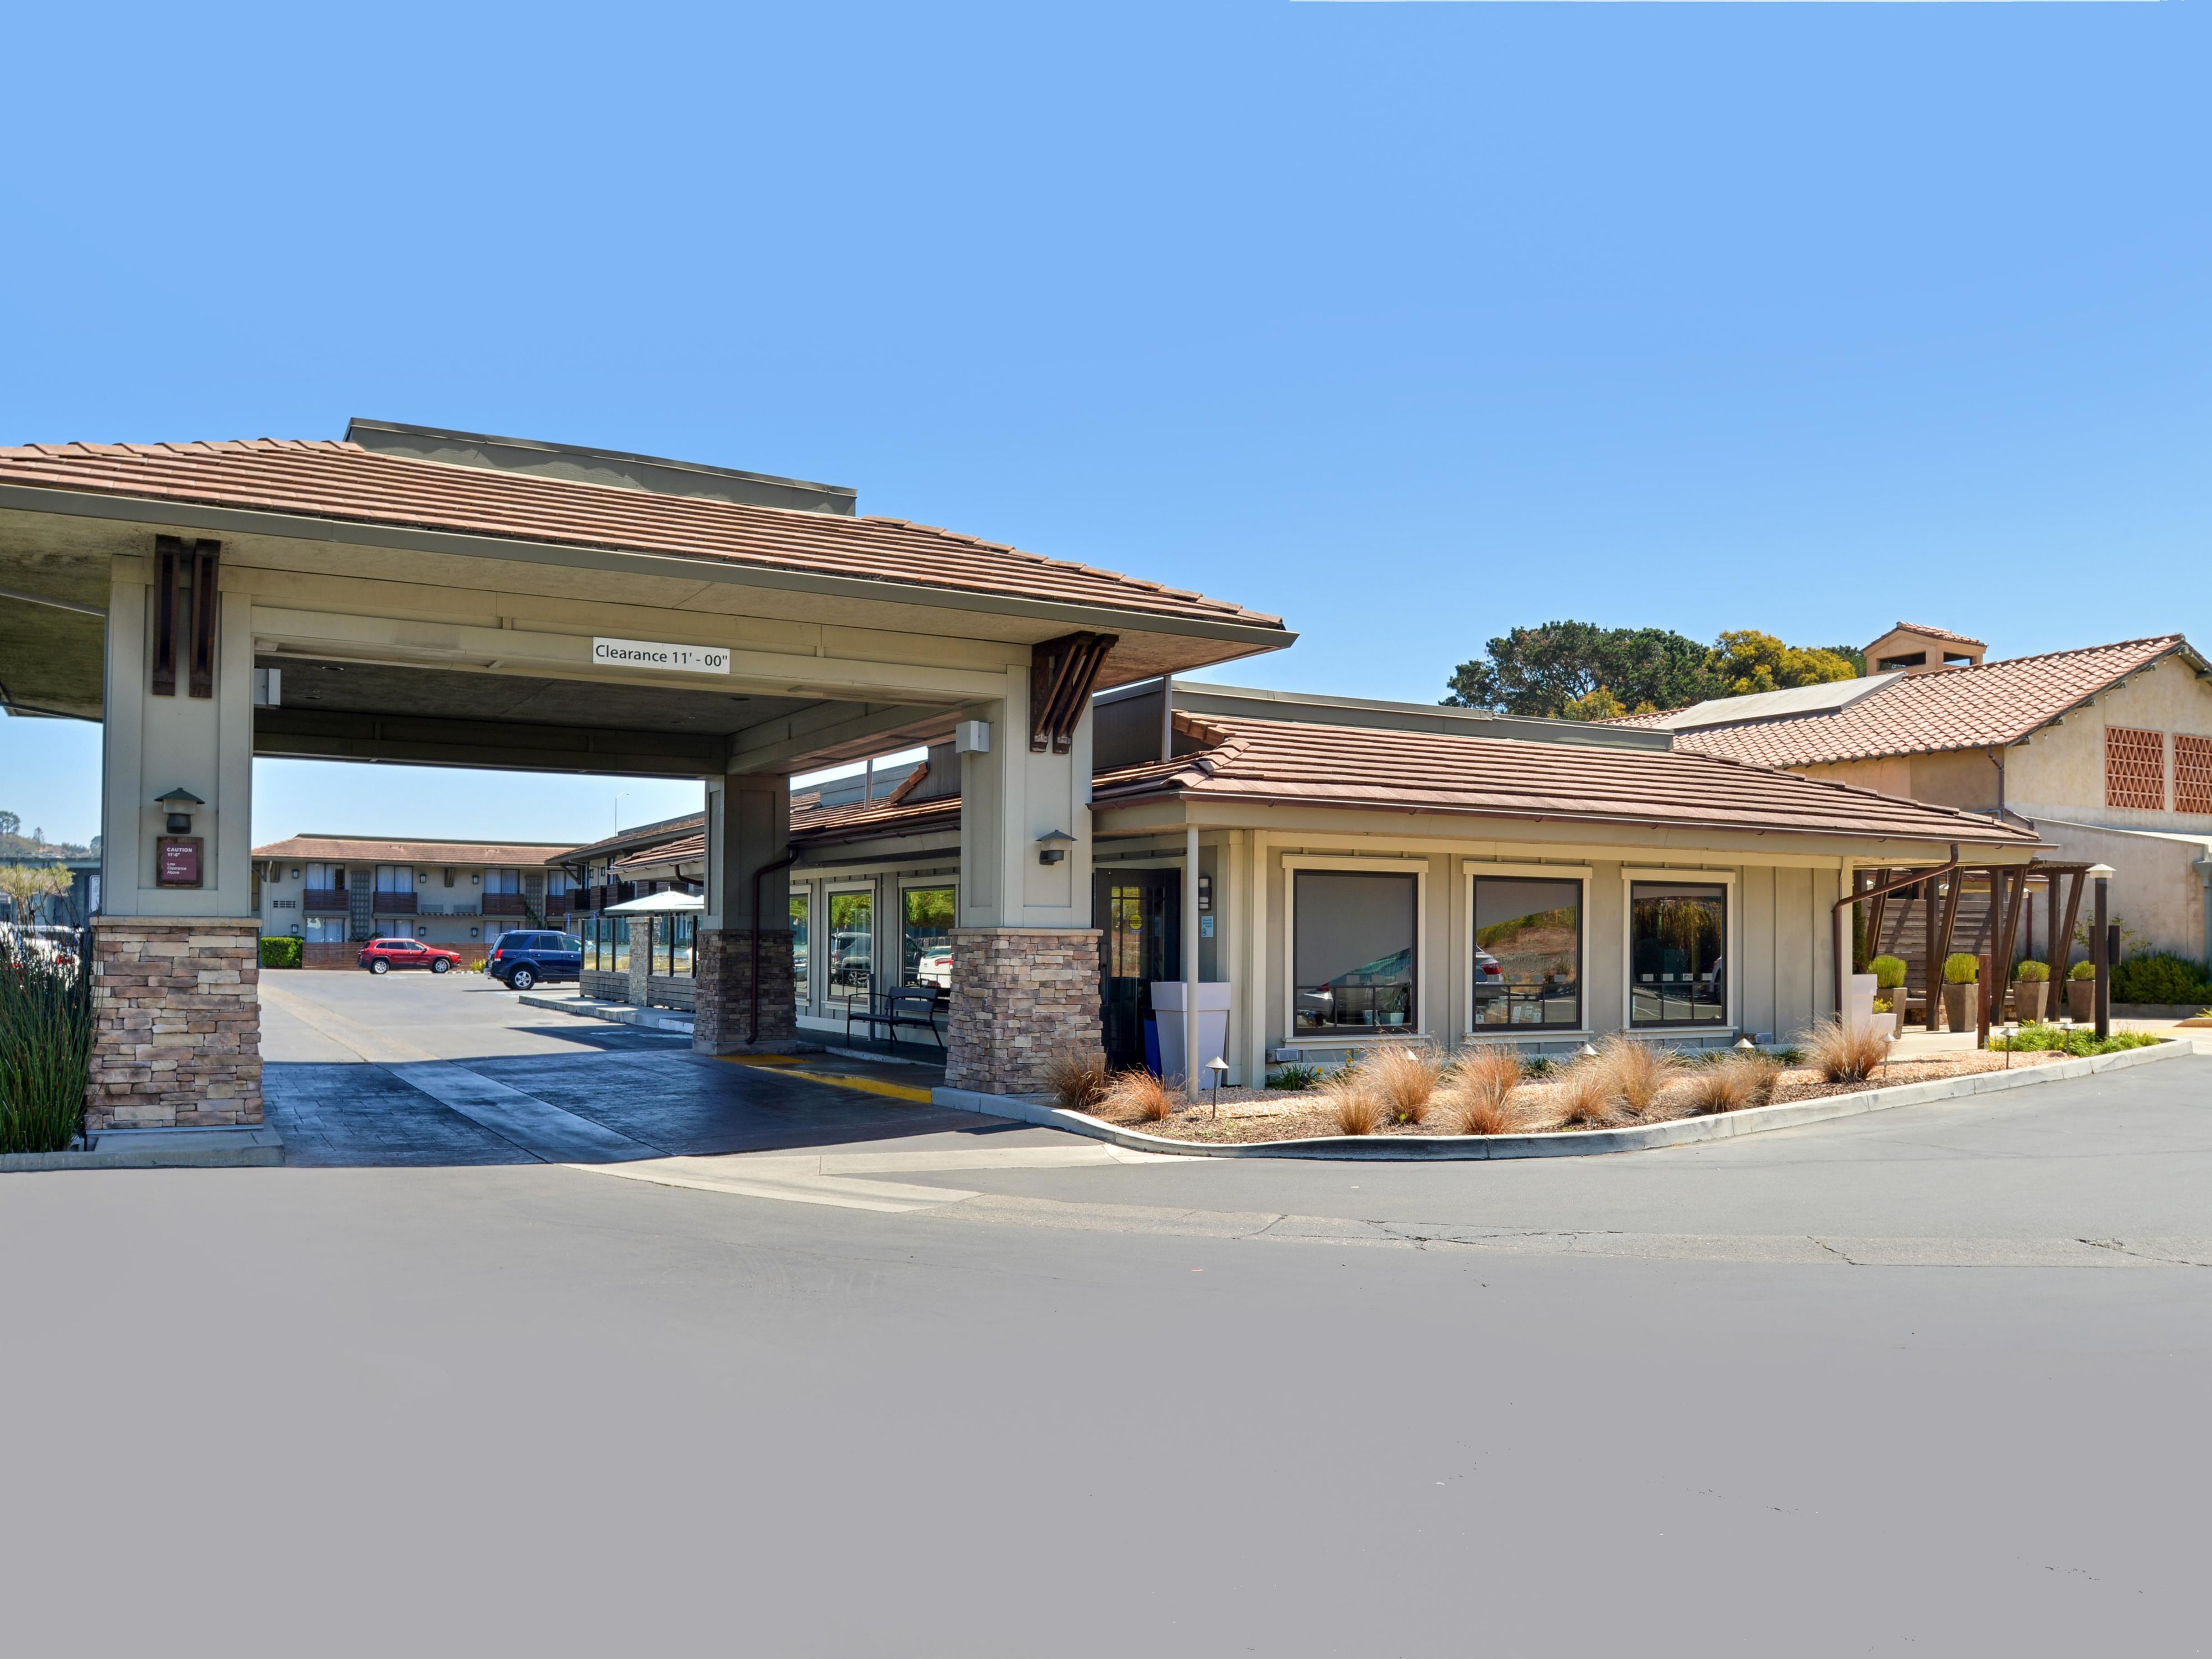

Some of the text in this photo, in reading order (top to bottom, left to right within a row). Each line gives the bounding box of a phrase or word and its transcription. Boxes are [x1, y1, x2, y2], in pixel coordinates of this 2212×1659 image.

[596, 644, 667, 662] Clearance
[672, 651, 692, 664] 11'
[704, 654, 728, 667] 00"
